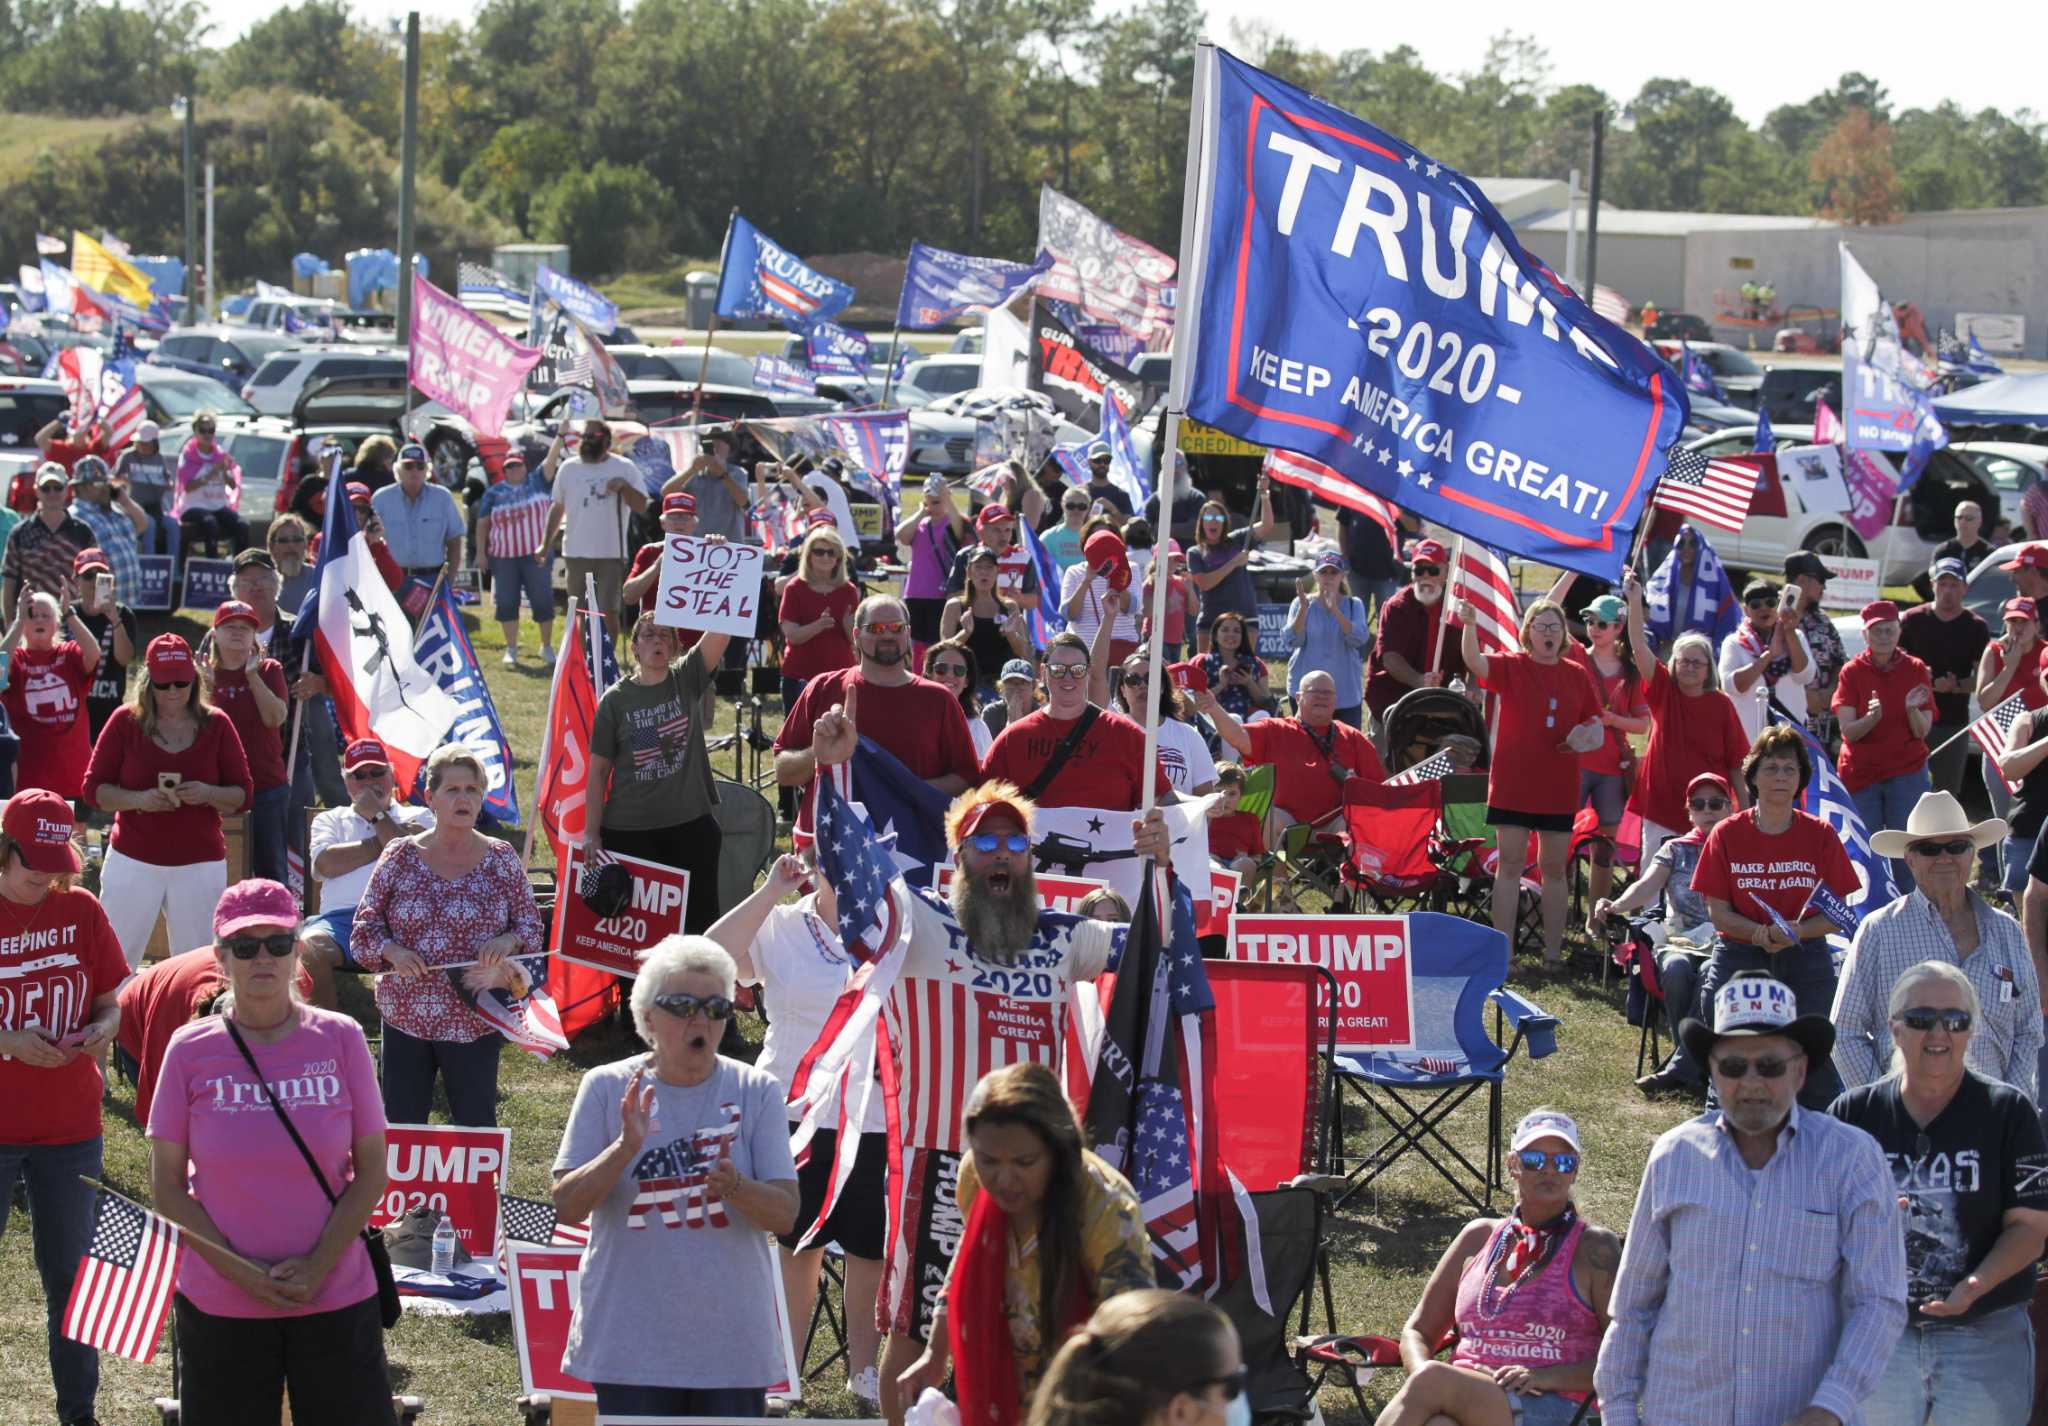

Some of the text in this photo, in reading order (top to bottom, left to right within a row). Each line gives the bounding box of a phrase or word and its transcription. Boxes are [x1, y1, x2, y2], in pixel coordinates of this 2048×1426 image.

[753, 233, 833, 297] TRUMP
[1041, 327, 1074, 348] GUN
[1090, 335, 1136, 353] RUMP
[1182, 436, 1241, 452] CREDIT
[1250, 345, 1609, 521] KEEP AMERICA GREAT!
[851, 509, 877, 517] UMP
[671, 537, 758, 569] STOP
[190, 572, 227, 585] TRU
[685, 569, 738, 589] THE
[1829, 566, 1875, 581] RUMP
[194, 583, 226, 592] PEN
[665, 586, 753, 618] STEAL
[1258, 614, 1288, 630] RUM
[1027, 737, 1099, 760] HUEY
[1730, 861, 1817, 875] MAKE AMERICA
[572, 860, 682, 916] TMP
[1737, 878, 1777, 890] GREAT
[1822, 889, 1858, 926] TRUM
[0, 925, 77, 955] EEPING IT
[594, 916, 648, 943] 2020
[575, 933, 597, 947] KEEP
[597, 940, 631, 957] AMERICA
[1237, 934, 1404, 972] TRUMP
[971, 963, 1053, 998] 2020
[1720, 983, 1790, 1005] RUM
[1724, 1000, 1790, 1014] ENC
[1347, 1016, 1388, 1028] GREAT!
[998, 1026, 1041, 1041] GREAT
[302, 1059, 337, 1077] 2020
[206, 1074, 340, 1106] Trump
[386, 1143, 500, 1184] UMP
[929, 1154, 963, 1257] RUMP
[1525, 1322, 1567, 1341] 2020
[1471, 1337, 1563, 1360] President
